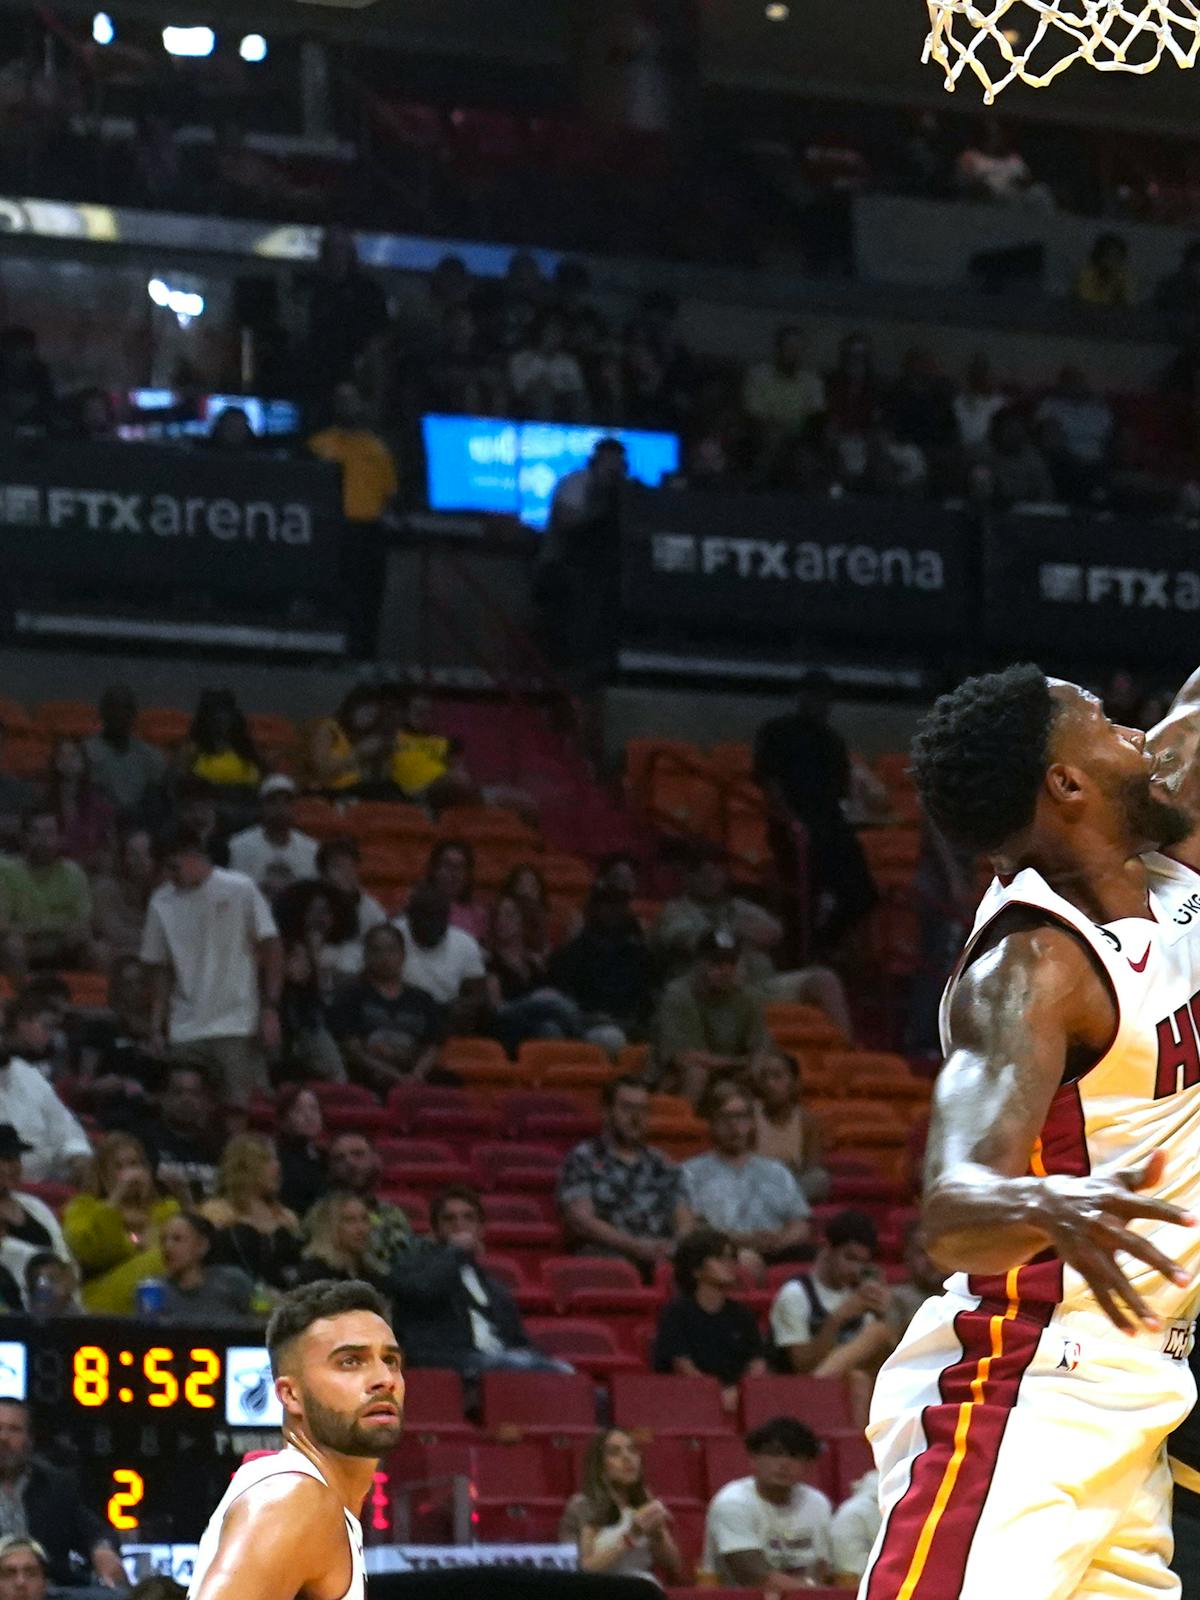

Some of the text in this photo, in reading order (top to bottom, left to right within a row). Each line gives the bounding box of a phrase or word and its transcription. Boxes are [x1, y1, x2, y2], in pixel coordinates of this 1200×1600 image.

[47, 487, 313, 545] FTX arena
[701, 535, 945, 590] FTX arena
[1087, 564, 1169, 609] FTX
[72, 1345, 221, 1408] 8:52
[107, 1468, 144, 1530] 2
